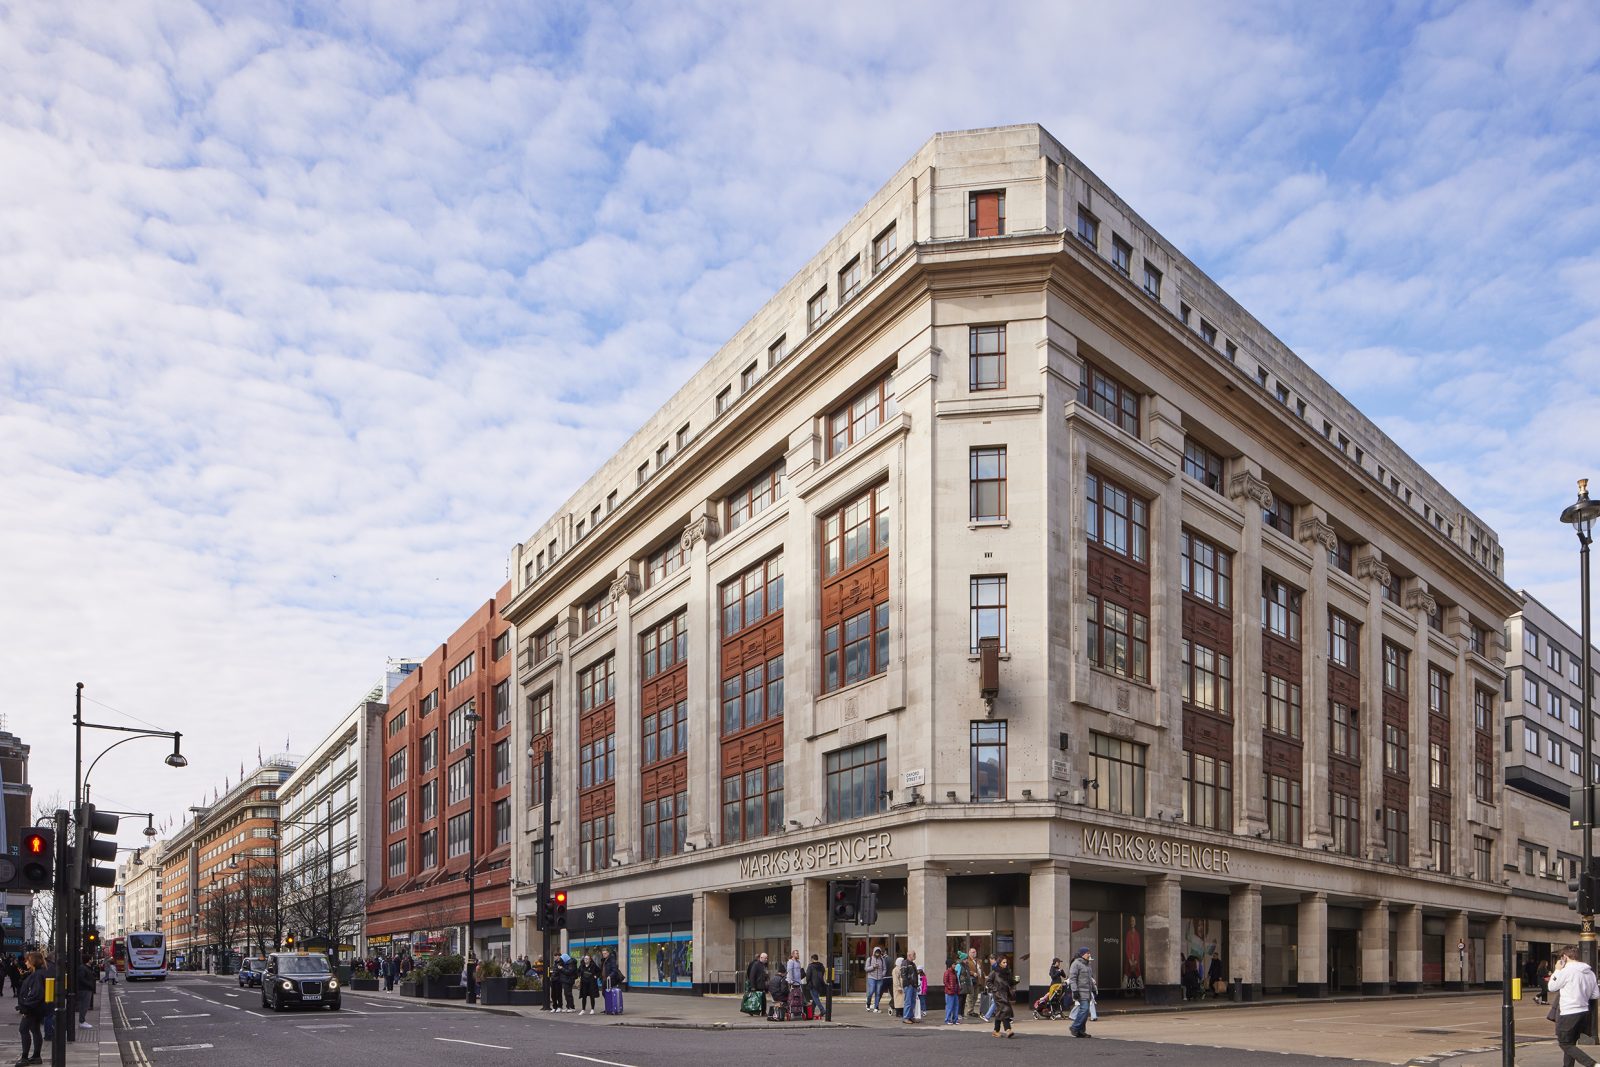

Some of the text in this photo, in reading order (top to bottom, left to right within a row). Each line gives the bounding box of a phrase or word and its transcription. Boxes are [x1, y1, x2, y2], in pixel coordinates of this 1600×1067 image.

[739, 832, 893, 879] MARKS & SPENCER
[1083, 828, 1231, 874] MARKS & SPENCER
[764, 894, 777, 904] M&S
[651, 904, 662, 913] M&S
[586, 911, 595, 920] M&S
